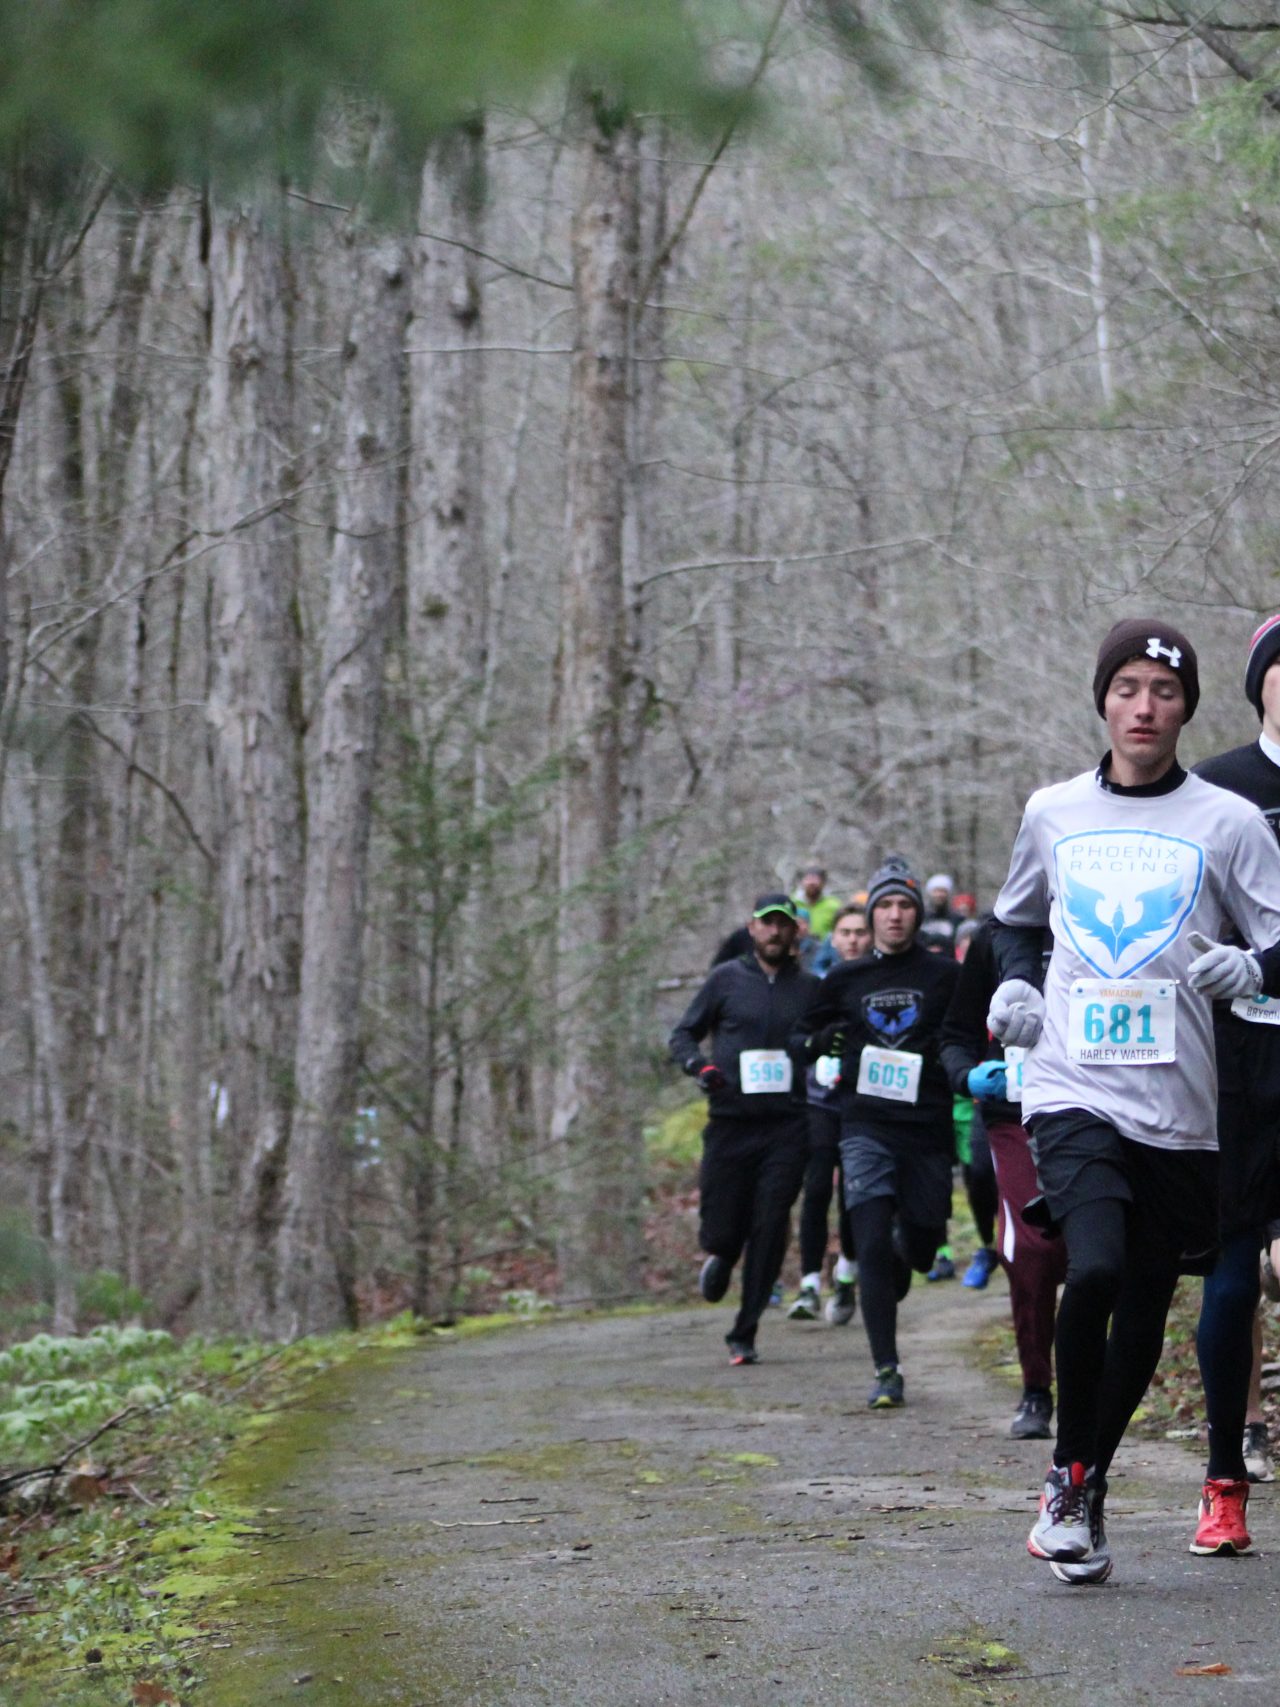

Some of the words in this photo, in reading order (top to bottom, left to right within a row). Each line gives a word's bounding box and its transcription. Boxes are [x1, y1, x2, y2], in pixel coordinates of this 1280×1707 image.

[1071, 845, 1179, 860] PHOENIX
[1070, 860, 1179, 874] RACING
[1246, 1006, 1280, 1021] BRYSON
[1083, 1003, 1156, 1044] 681
[1080, 1049, 1117, 1061] HARLEY
[1120, 1049, 1160, 1060] WATERS
[868, 1061, 909, 1090] 605
